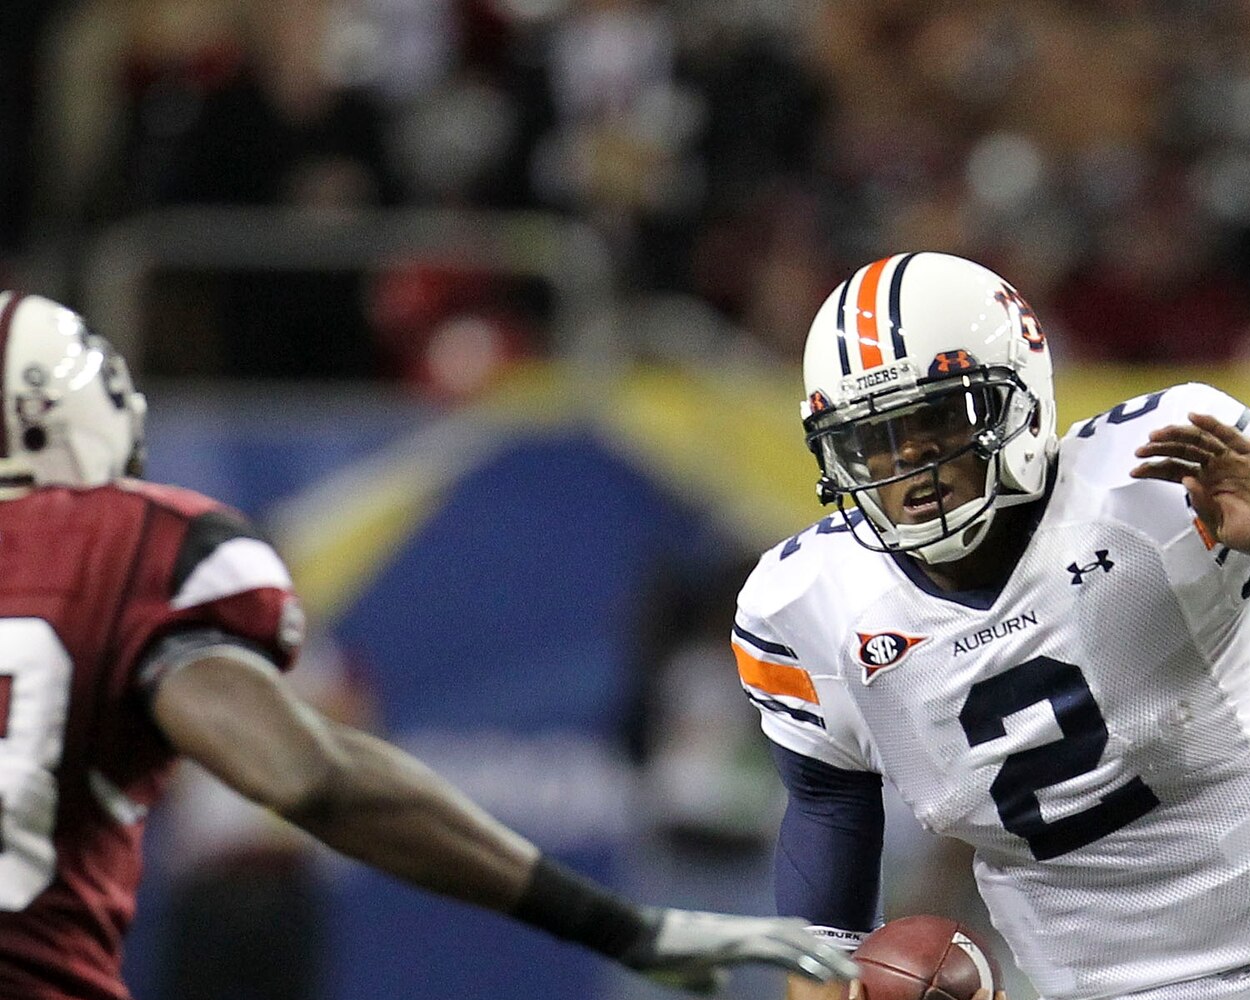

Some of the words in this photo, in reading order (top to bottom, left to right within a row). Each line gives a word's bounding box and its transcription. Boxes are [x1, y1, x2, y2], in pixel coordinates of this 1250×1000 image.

[856, 367, 899, 391] TIGERS
[866, 635, 899, 665] SEC
[953, 611, 1039, 657] AUBURN
[958, 655, 1161, 862] 2
